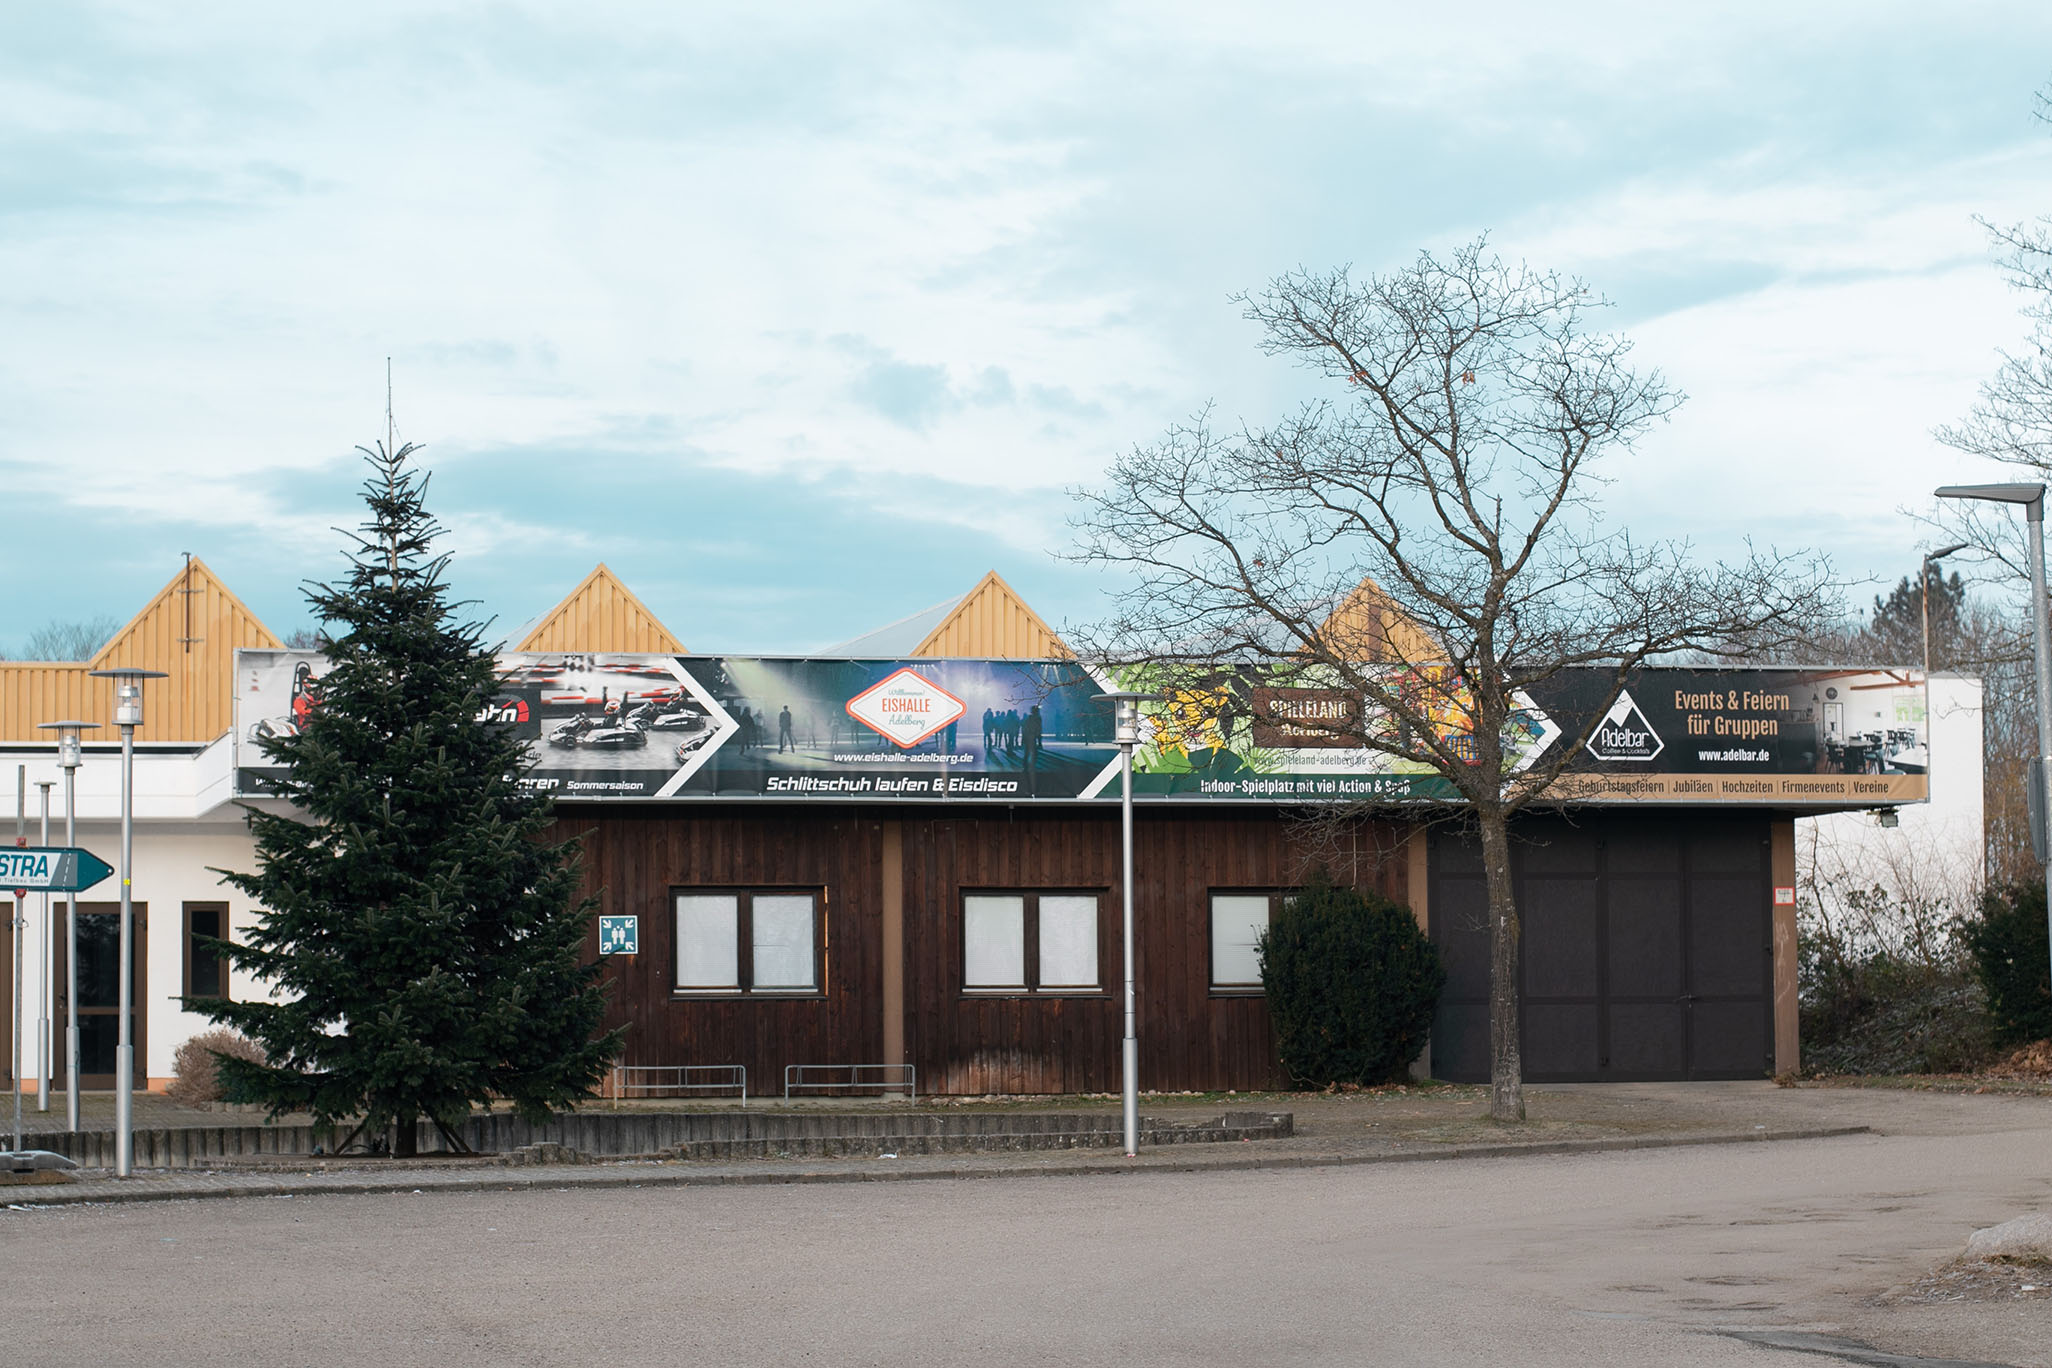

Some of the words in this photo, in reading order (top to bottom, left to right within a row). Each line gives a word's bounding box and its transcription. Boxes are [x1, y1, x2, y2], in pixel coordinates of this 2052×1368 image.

[882, 698, 931, 712] EISHALLE
[1675, 690, 1723, 710] Events
[1727, 690, 1739, 710] &
[1743, 690, 1790, 711] Feiern
[888, 714, 925, 729] Adelberg
[1687, 714, 1710, 735] für
[1714, 716, 1778, 740] Gruppen
[1601, 728, 1649, 747] Adelbar
[833, 752, 974, 764] www.eishalle-adelberg.de
[1698, 749, 1769, 761] www.adelbar.de
[567, 780, 644, 790] Sommersaison
[766, 777, 871, 792] Schlittschuh
[875, 777, 928, 792] laufen
[932, 778, 944, 791] &
[948, 778, 1018, 792] Eisdisco
[1200, 778, 1295, 796] Indoor-Spielplatz
[1296, 780, 1315, 793] mit
[1316, 779, 1336, 793] viel
[1339, 779, 1372, 793] Action
[1374, 780, 1383, 793] &
[1673, 779, 1713, 793] Jubiläen
[1722, 780, 1773, 794] Hochzeiten
[1782, 780, 1845, 793] Firmenevents
[1853, 780, 1889, 793] Vereine
